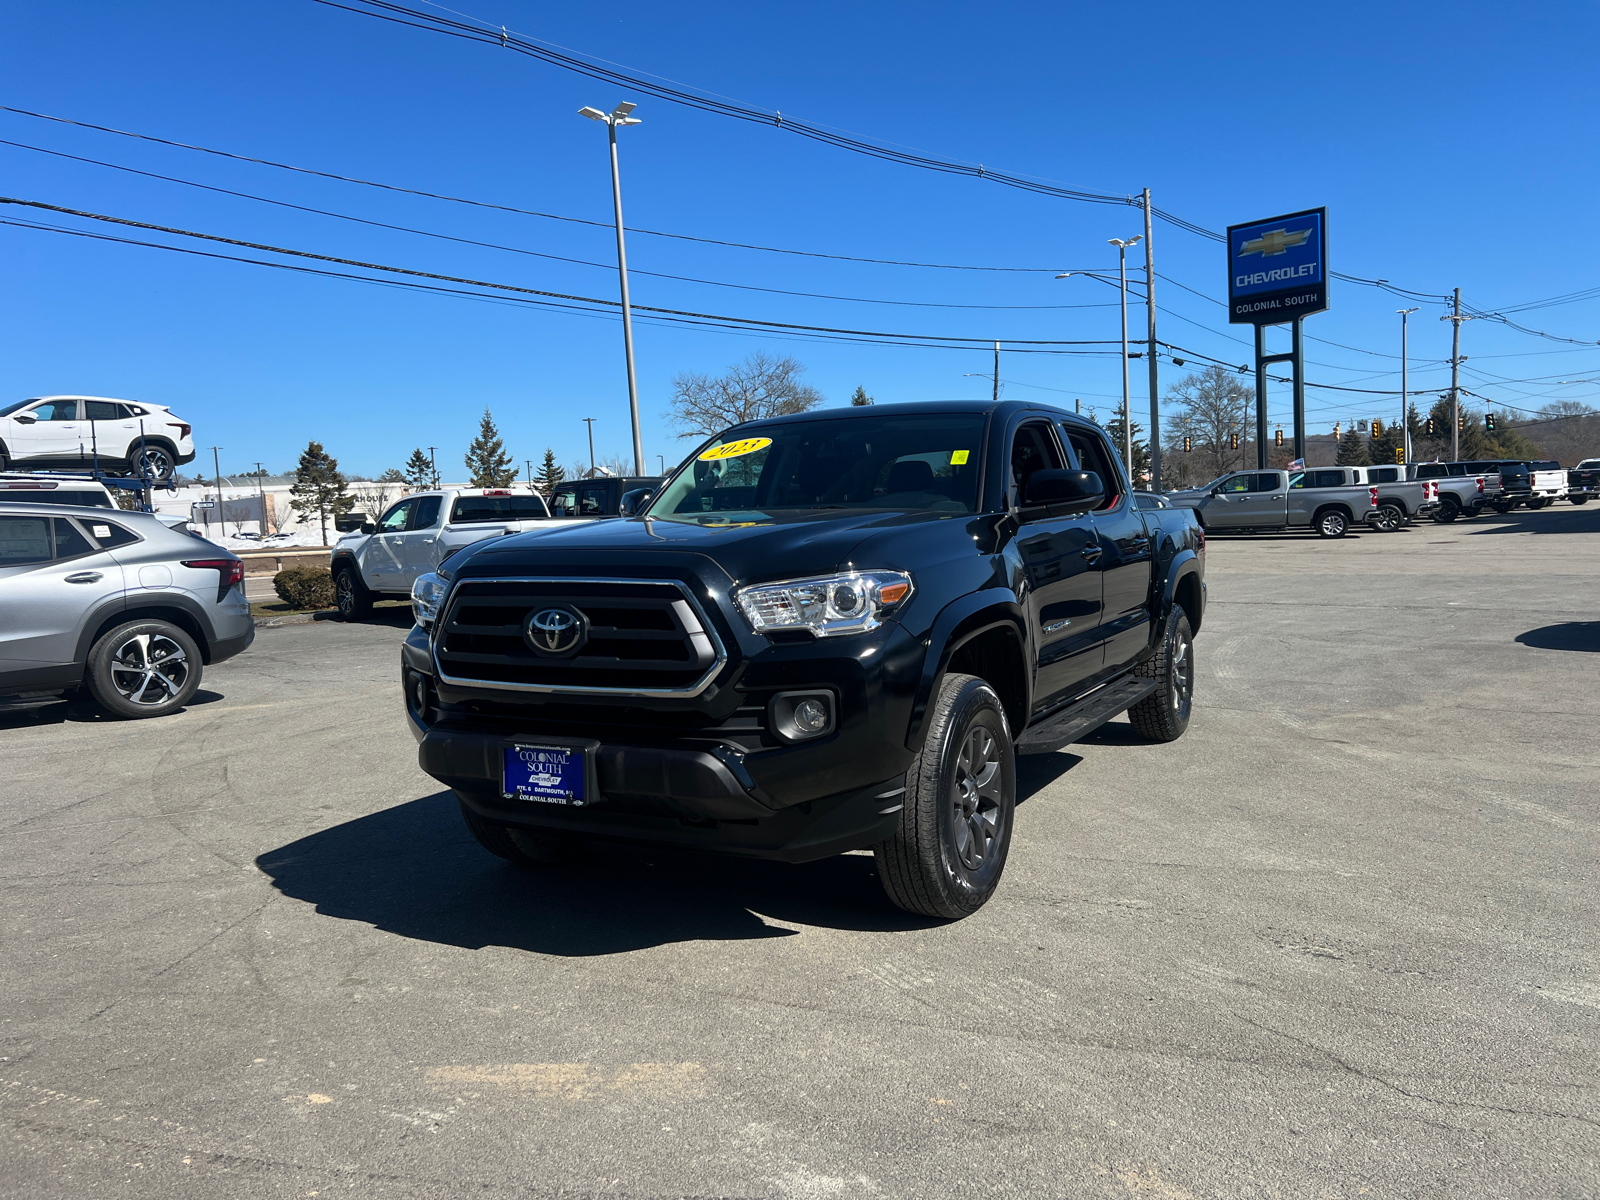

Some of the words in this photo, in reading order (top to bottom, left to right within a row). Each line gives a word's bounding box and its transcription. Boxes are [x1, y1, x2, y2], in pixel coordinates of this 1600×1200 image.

[1236, 263, 1316, 287] CHEVROLET
[1236, 300, 1282, 314] COLONIAL
[1285, 294, 1317, 306] SOUTH
[707, 440, 761, 458] 2023
[520, 751, 569, 764] COLONIAL
[527, 762, 562, 774] SOUTH
[531, 776, 558, 784] CHEVROLET
[534, 787, 565, 795] DARTMOUTH,
[519, 795, 547, 803] COLONIAL
